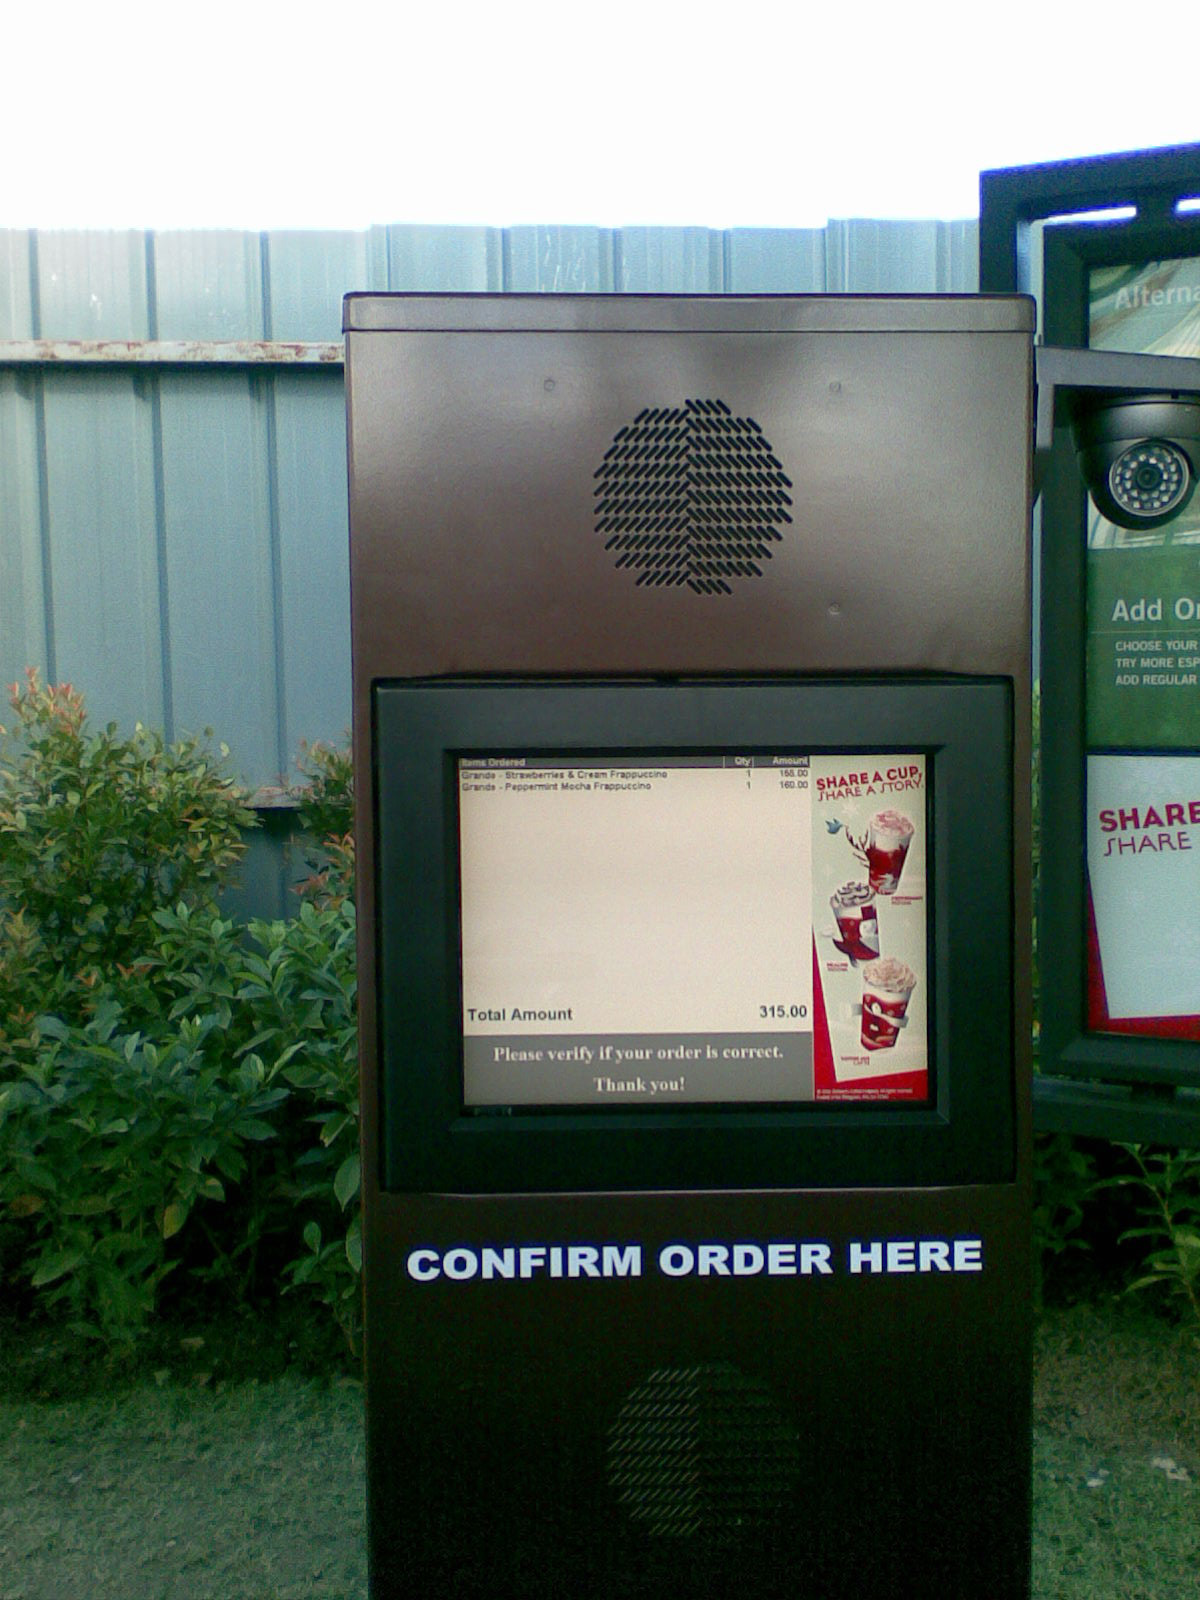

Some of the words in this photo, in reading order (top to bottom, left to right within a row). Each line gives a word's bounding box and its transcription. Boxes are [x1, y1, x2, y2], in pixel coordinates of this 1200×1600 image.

[1112, 598, 1162, 621] Add
[1115, 641, 1162, 652] CHOOSE
[1167, 640, 1198, 651] YOUR
[1116, 658, 1136, 668] TRY
[1141, 658, 1174, 668] MORE
[1116, 675, 1139, 685] ADD
[1143, 674, 1197, 685] REGULAR
[462, 758, 486, 767] Items
[488, 758, 526, 767] Ordered
[734, 756, 751, 766] Qty
[773, 755, 808, 765] Amount
[462, 771, 496, 780] Grande
[505, 771, 564, 779] Strawberries
[568, 770, 574, 779] &
[577, 770, 607, 779] Cream
[610, 769, 668, 780] Frappuccino
[816, 772, 869, 791] SHARE
[872, 771, 884, 784] A
[462, 783, 496, 791] Grande
[505, 782, 558, 792] Peppermint
[561, 782, 591, 791] Mocha
[594, 781, 652, 792] Frappuccino
[780, 780, 809, 789] 160.00
[818, 785, 862, 802] SHARE
[866, 784, 877, 796] A
[1099, 801, 1200, 832] SHARE
[1103, 831, 1193, 857] SHARE
[467, 1009, 506, 1021] Total
[511, 1008, 573, 1021] Amount
[759, 1005, 807, 1018] 315.00
[493, 1046, 543, 1062] Please
[547, 1046, 593, 1064] verify
[599, 1045, 613, 1061] if
[614, 1048, 653, 1064] your
[656, 1044, 701, 1060] order
[706, 1044, 719, 1059] is
[722, 1044, 783, 1059] correct.
[594, 1077, 646, 1092] Thank
[650, 1076, 685, 1095] you!
[406, 1245, 642, 1282] CONFIRM
[658, 1242, 834, 1277] ORDER
[849, 1239, 983, 1274] HERE
